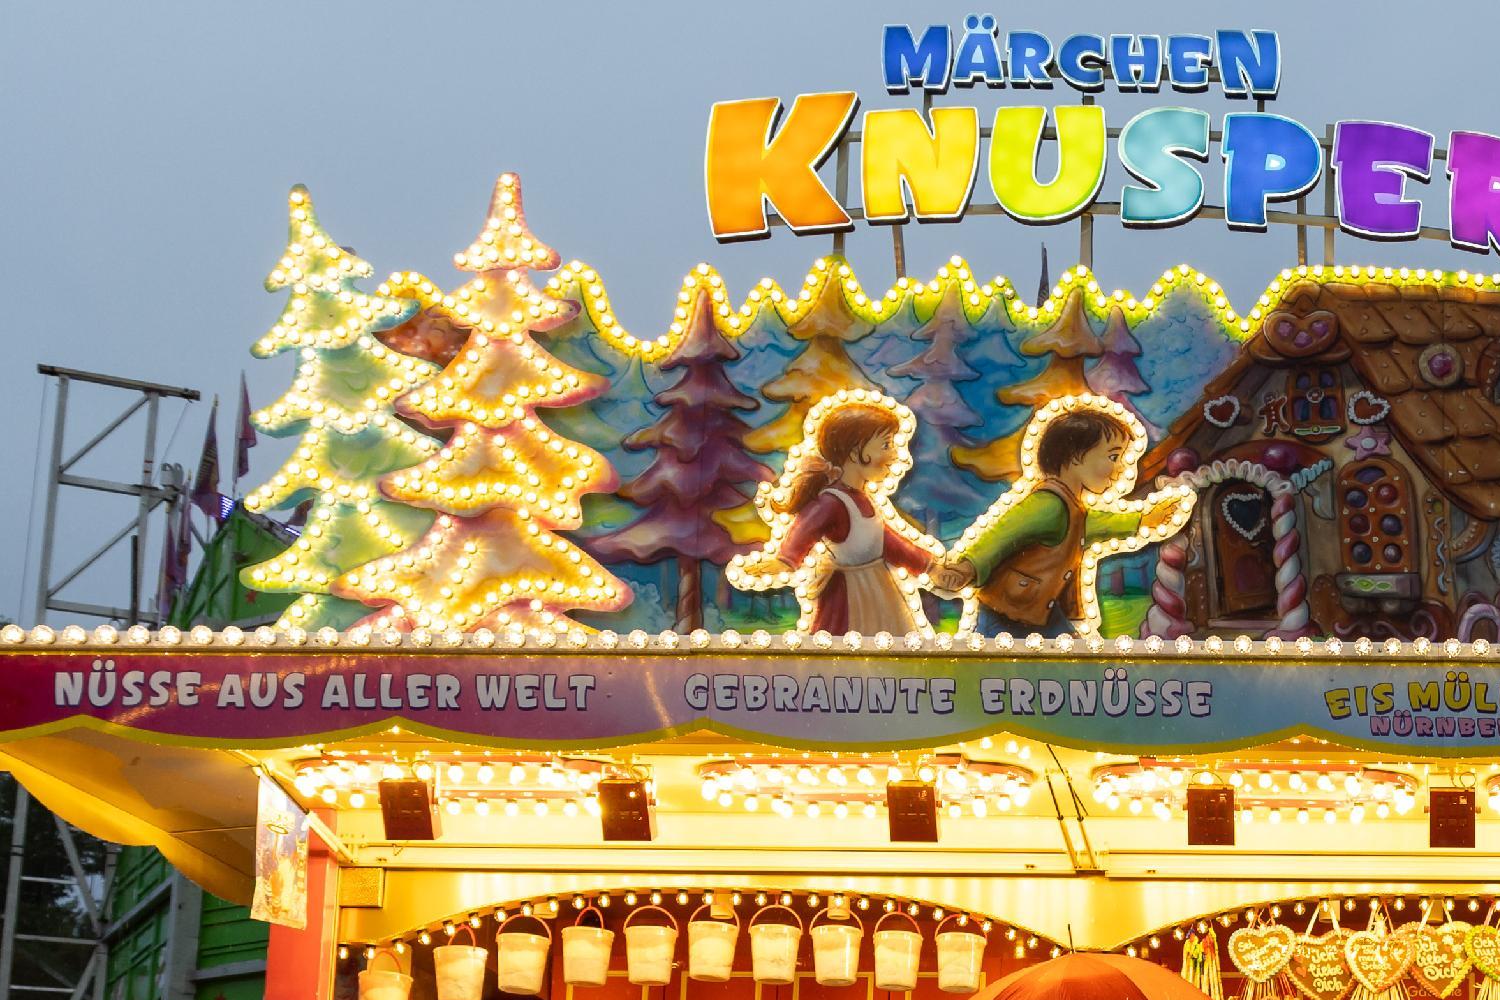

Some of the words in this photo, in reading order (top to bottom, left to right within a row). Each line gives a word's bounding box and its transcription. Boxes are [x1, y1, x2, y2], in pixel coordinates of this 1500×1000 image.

[882, 12, 1283, 99] MÄRCHEN
[54, 660, 200, 708] NÜSSE
[217, 672, 306, 709] AUS
[321, 672, 461, 709] ALLER
[476, 674, 597, 711] WELT
[684, 673, 956, 714] GEBRANNTE
[981, 668, 1213, 717] ERDNÜSSE
[1324, 682, 1394, 721] EIS
[1424, 964, 1459, 981] Dich
